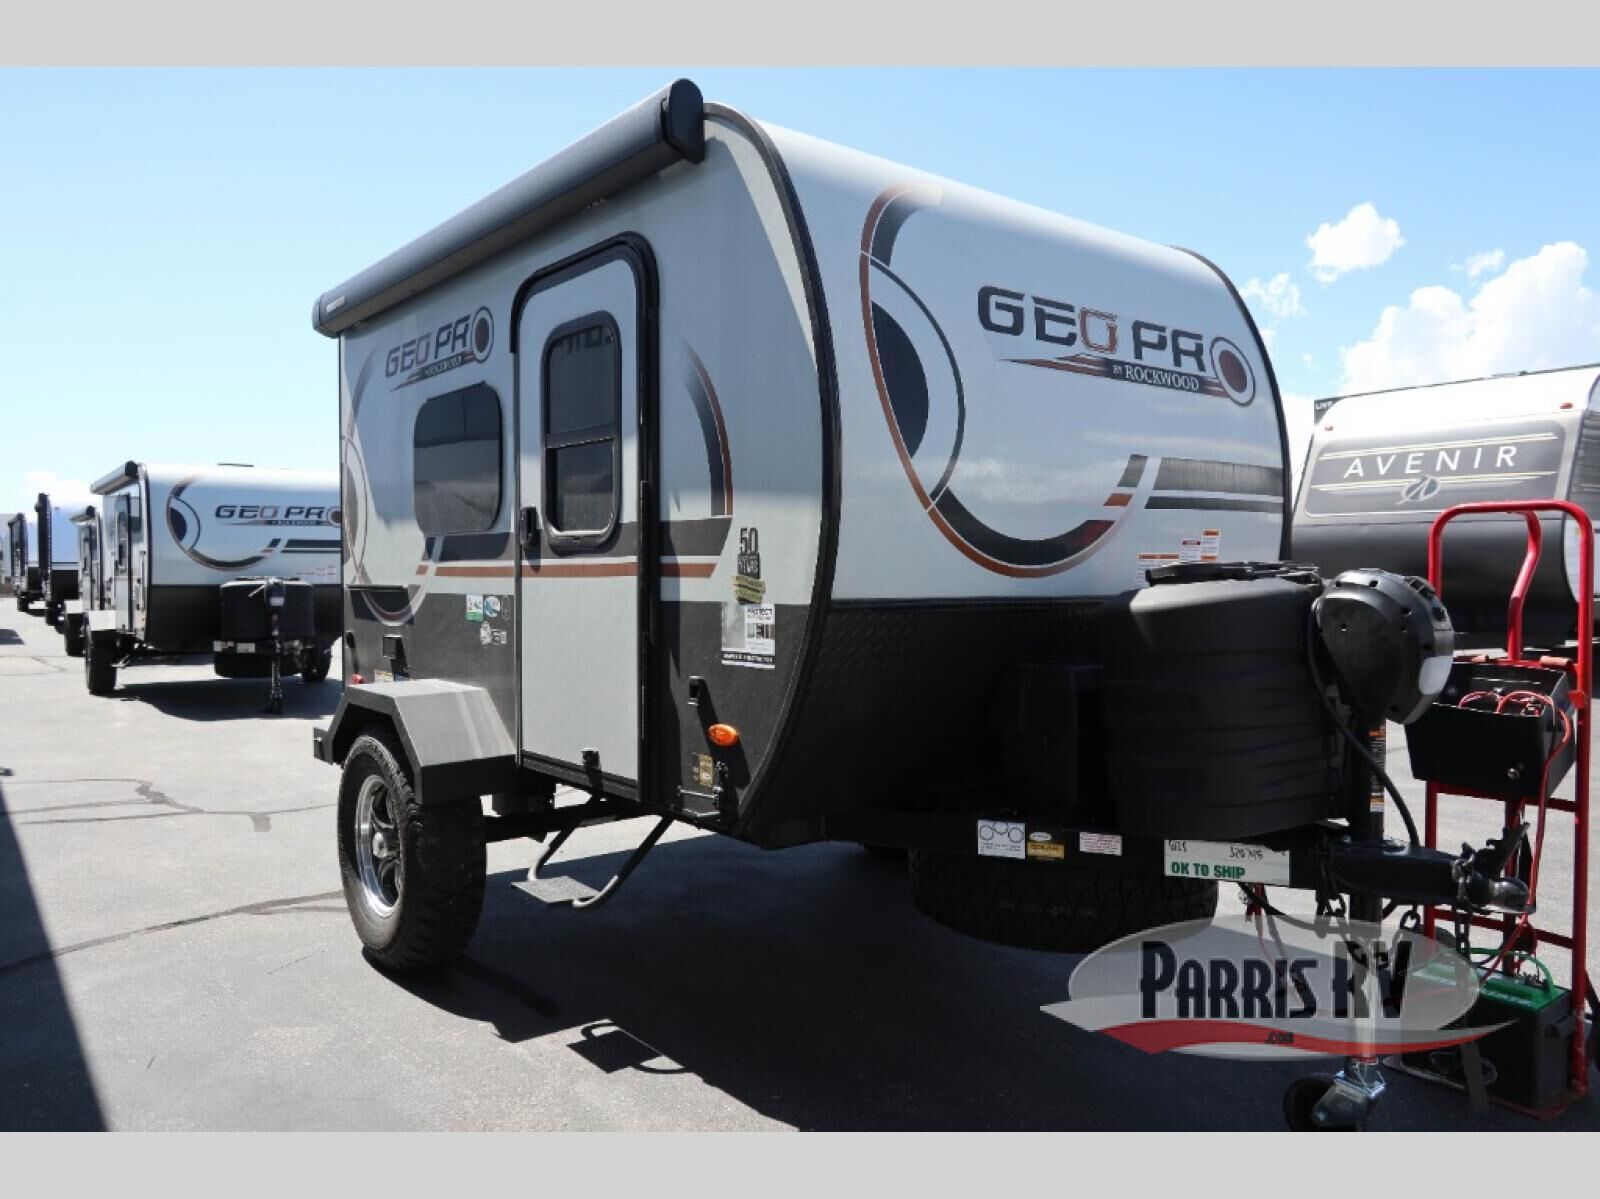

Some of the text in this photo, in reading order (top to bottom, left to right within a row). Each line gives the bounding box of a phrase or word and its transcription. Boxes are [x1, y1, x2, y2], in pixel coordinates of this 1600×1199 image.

[385, 332, 432, 378] GEO
[434, 306, 494, 364] PRO
[978, 286, 1256, 407] GEO PRO
[1124, 364, 1200, 392] ROCKWOOD
[1343, 446, 1517, 479] AVENIR
[215, 505, 279, 519] GEO
[740, 527, 759, 553] 50
[1171, 861, 1246, 879] OK TO SHIP
